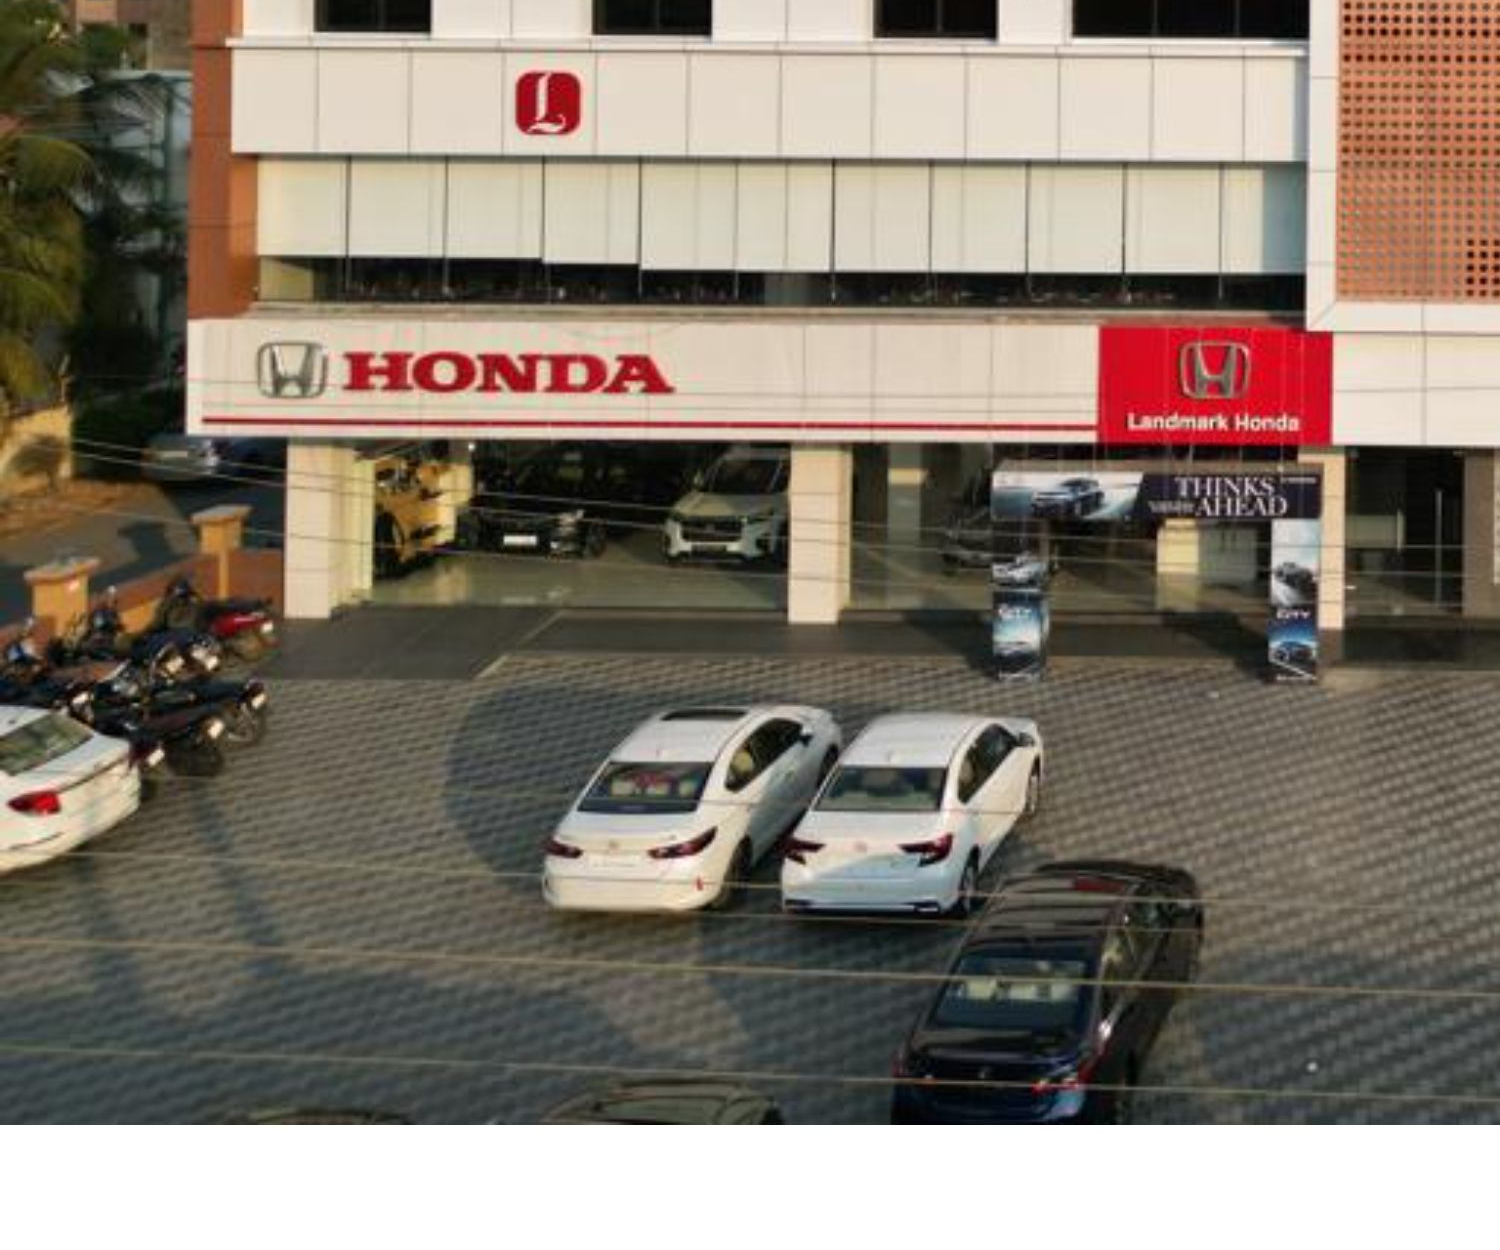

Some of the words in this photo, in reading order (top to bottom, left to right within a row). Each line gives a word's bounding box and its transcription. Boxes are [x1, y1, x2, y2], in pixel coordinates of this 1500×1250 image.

[342, 351, 676, 393] HONDA
[1126, 412, 1229, 431] Landmark
[1235, 413, 1300, 432] Honda
[1174, 476, 1275, 497] THINKS
[1194, 496, 1288, 517] AHEAD
